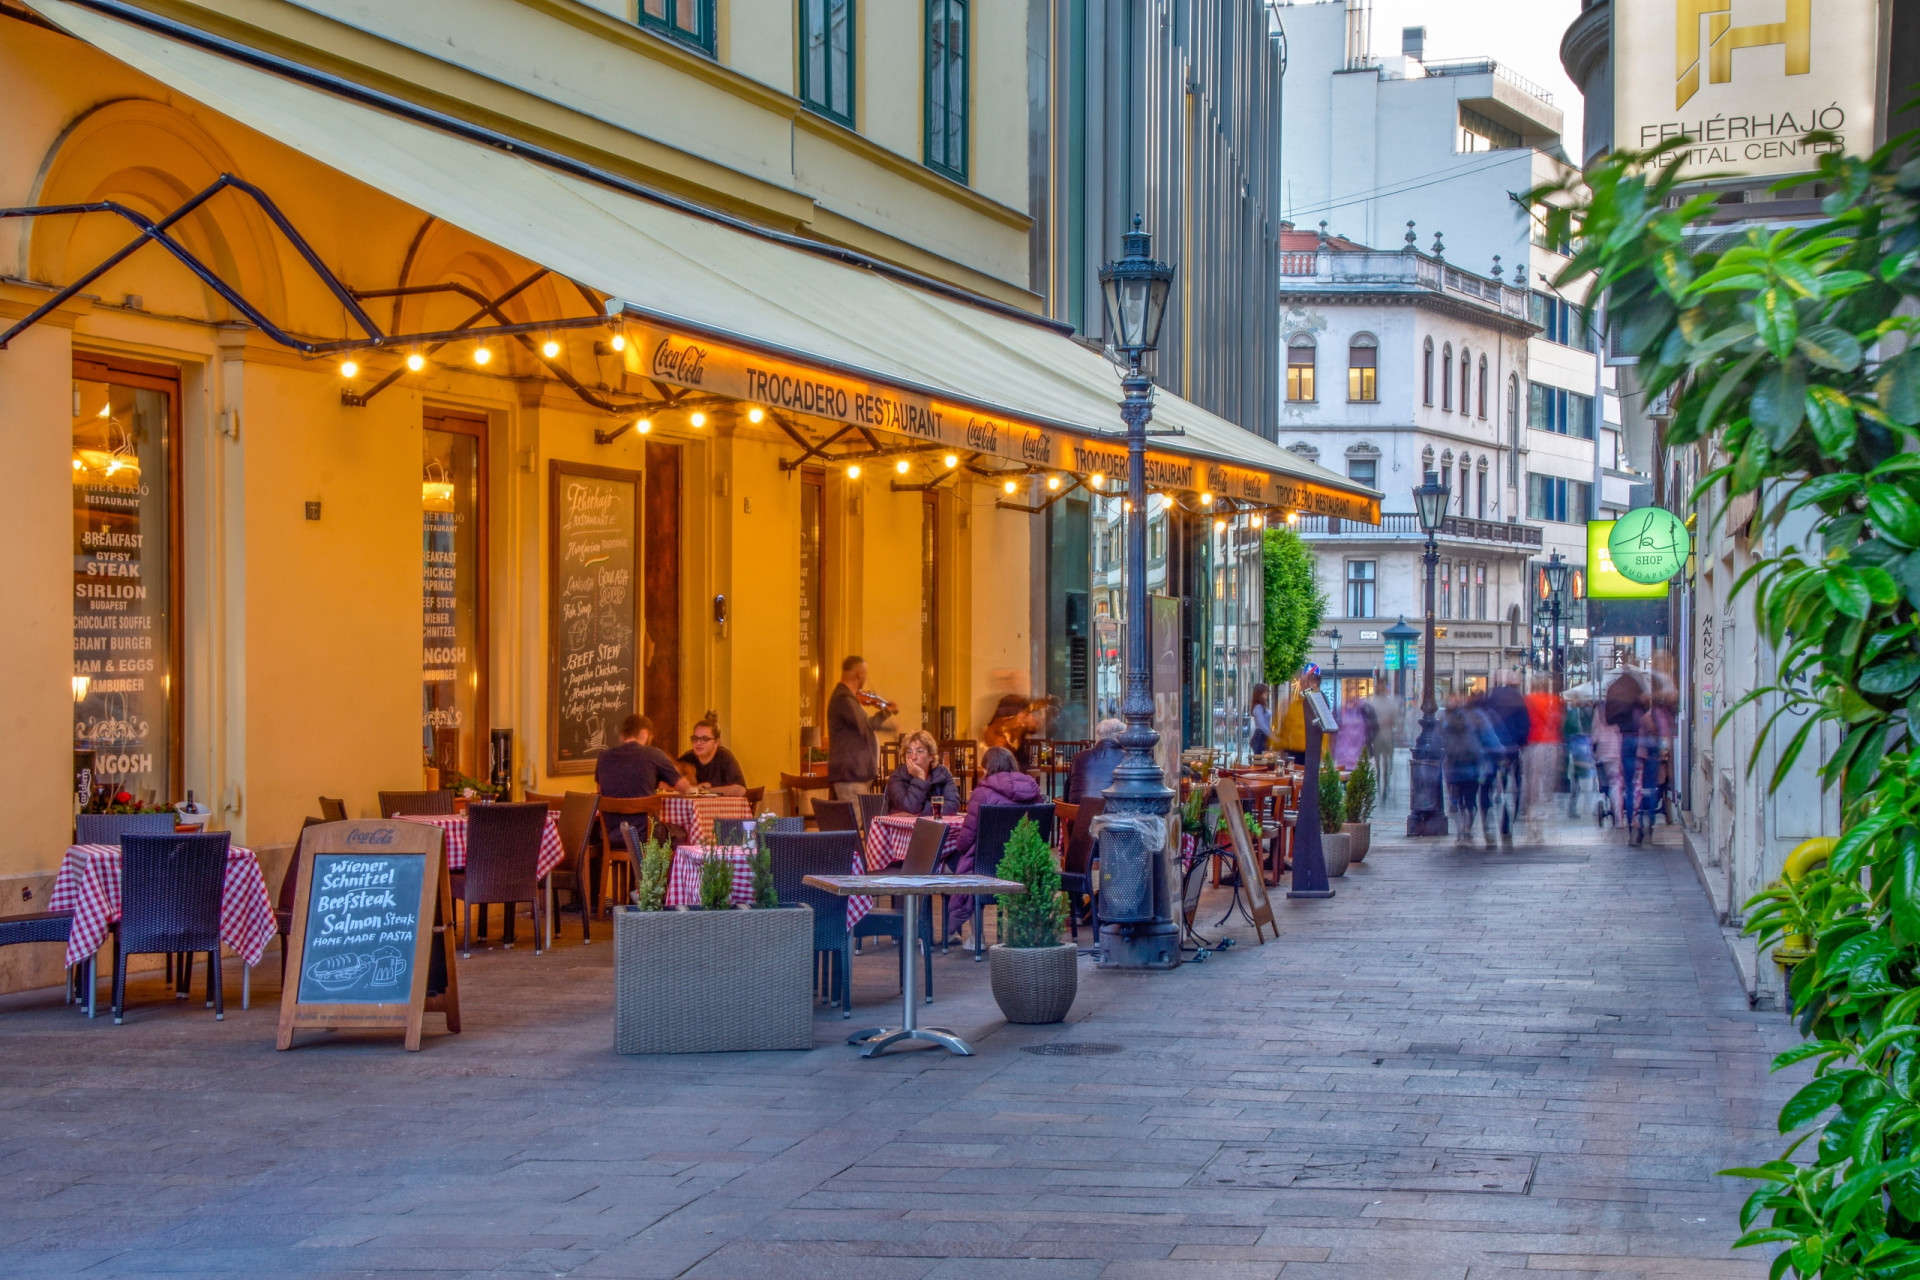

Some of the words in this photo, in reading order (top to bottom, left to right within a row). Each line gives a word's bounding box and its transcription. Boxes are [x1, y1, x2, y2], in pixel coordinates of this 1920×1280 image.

[1640, 101, 1845, 148] FEHÉRHAJÓ
[746, 367, 847, 418] TROCADERO
[855, 392, 943, 439] RESTAURANT
[1144, 459, 1192, 488] ESTAURANT
[84, 495, 139, 507] RESTAURANT
[1276, 484, 1312, 510] TROCADERO
[1315, 493, 1350, 516] RESTAURANT
[423, 524, 458, 533] ESTAURANT
[573, 514, 609, 527] RESTAURANT
[84, 531, 143, 548] BREAKFAST
[96, 551, 131, 562] GYPSY
[422, 551, 457, 563] REAKFAST
[1635, 555, 1663, 565] SHOP
[87, 561, 140, 577] STEAK
[423, 567, 456, 579] HICKEN
[1622, 563, 1676, 579] BUDAPEST
[75, 583, 147, 599] SIRLION
[599, 586, 626, 607] SOUP
[90, 600, 128, 610] BUDAPEST
[422, 597, 434, 608] EEF
[436, 596, 457, 609] STEW
[74, 616, 117, 629] CHOCOLATE
[119, 616, 151, 629] SOUFFLE
[424, 612, 450, 624] WIENER
[423, 626, 457, 637] CHNITZEL
[74, 636, 107, 650] GRANT
[110, 636, 152, 650] BURGER
[423, 647, 466, 664] NGOSH
[562, 650, 595, 671] BEEF
[597, 643, 621, 662] STEW
[74, 660, 101, 673] HAM
[105, 659, 115, 672] &
[118, 658, 154, 672] EGGS
[95, 753, 152, 774] NGOSH
[330, 860, 389, 873] Wiener
[321, 868, 395, 891] Schnitzel
[317, 890, 397, 915] Beefsteak
[321, 913, 382, 934] Salmon
[383, 911, 415, 926] Steak
[313, 936, 343, 947] HOME
[343, 933, 377, 945] MADE
[378, 930, 413, 943] PASTA
